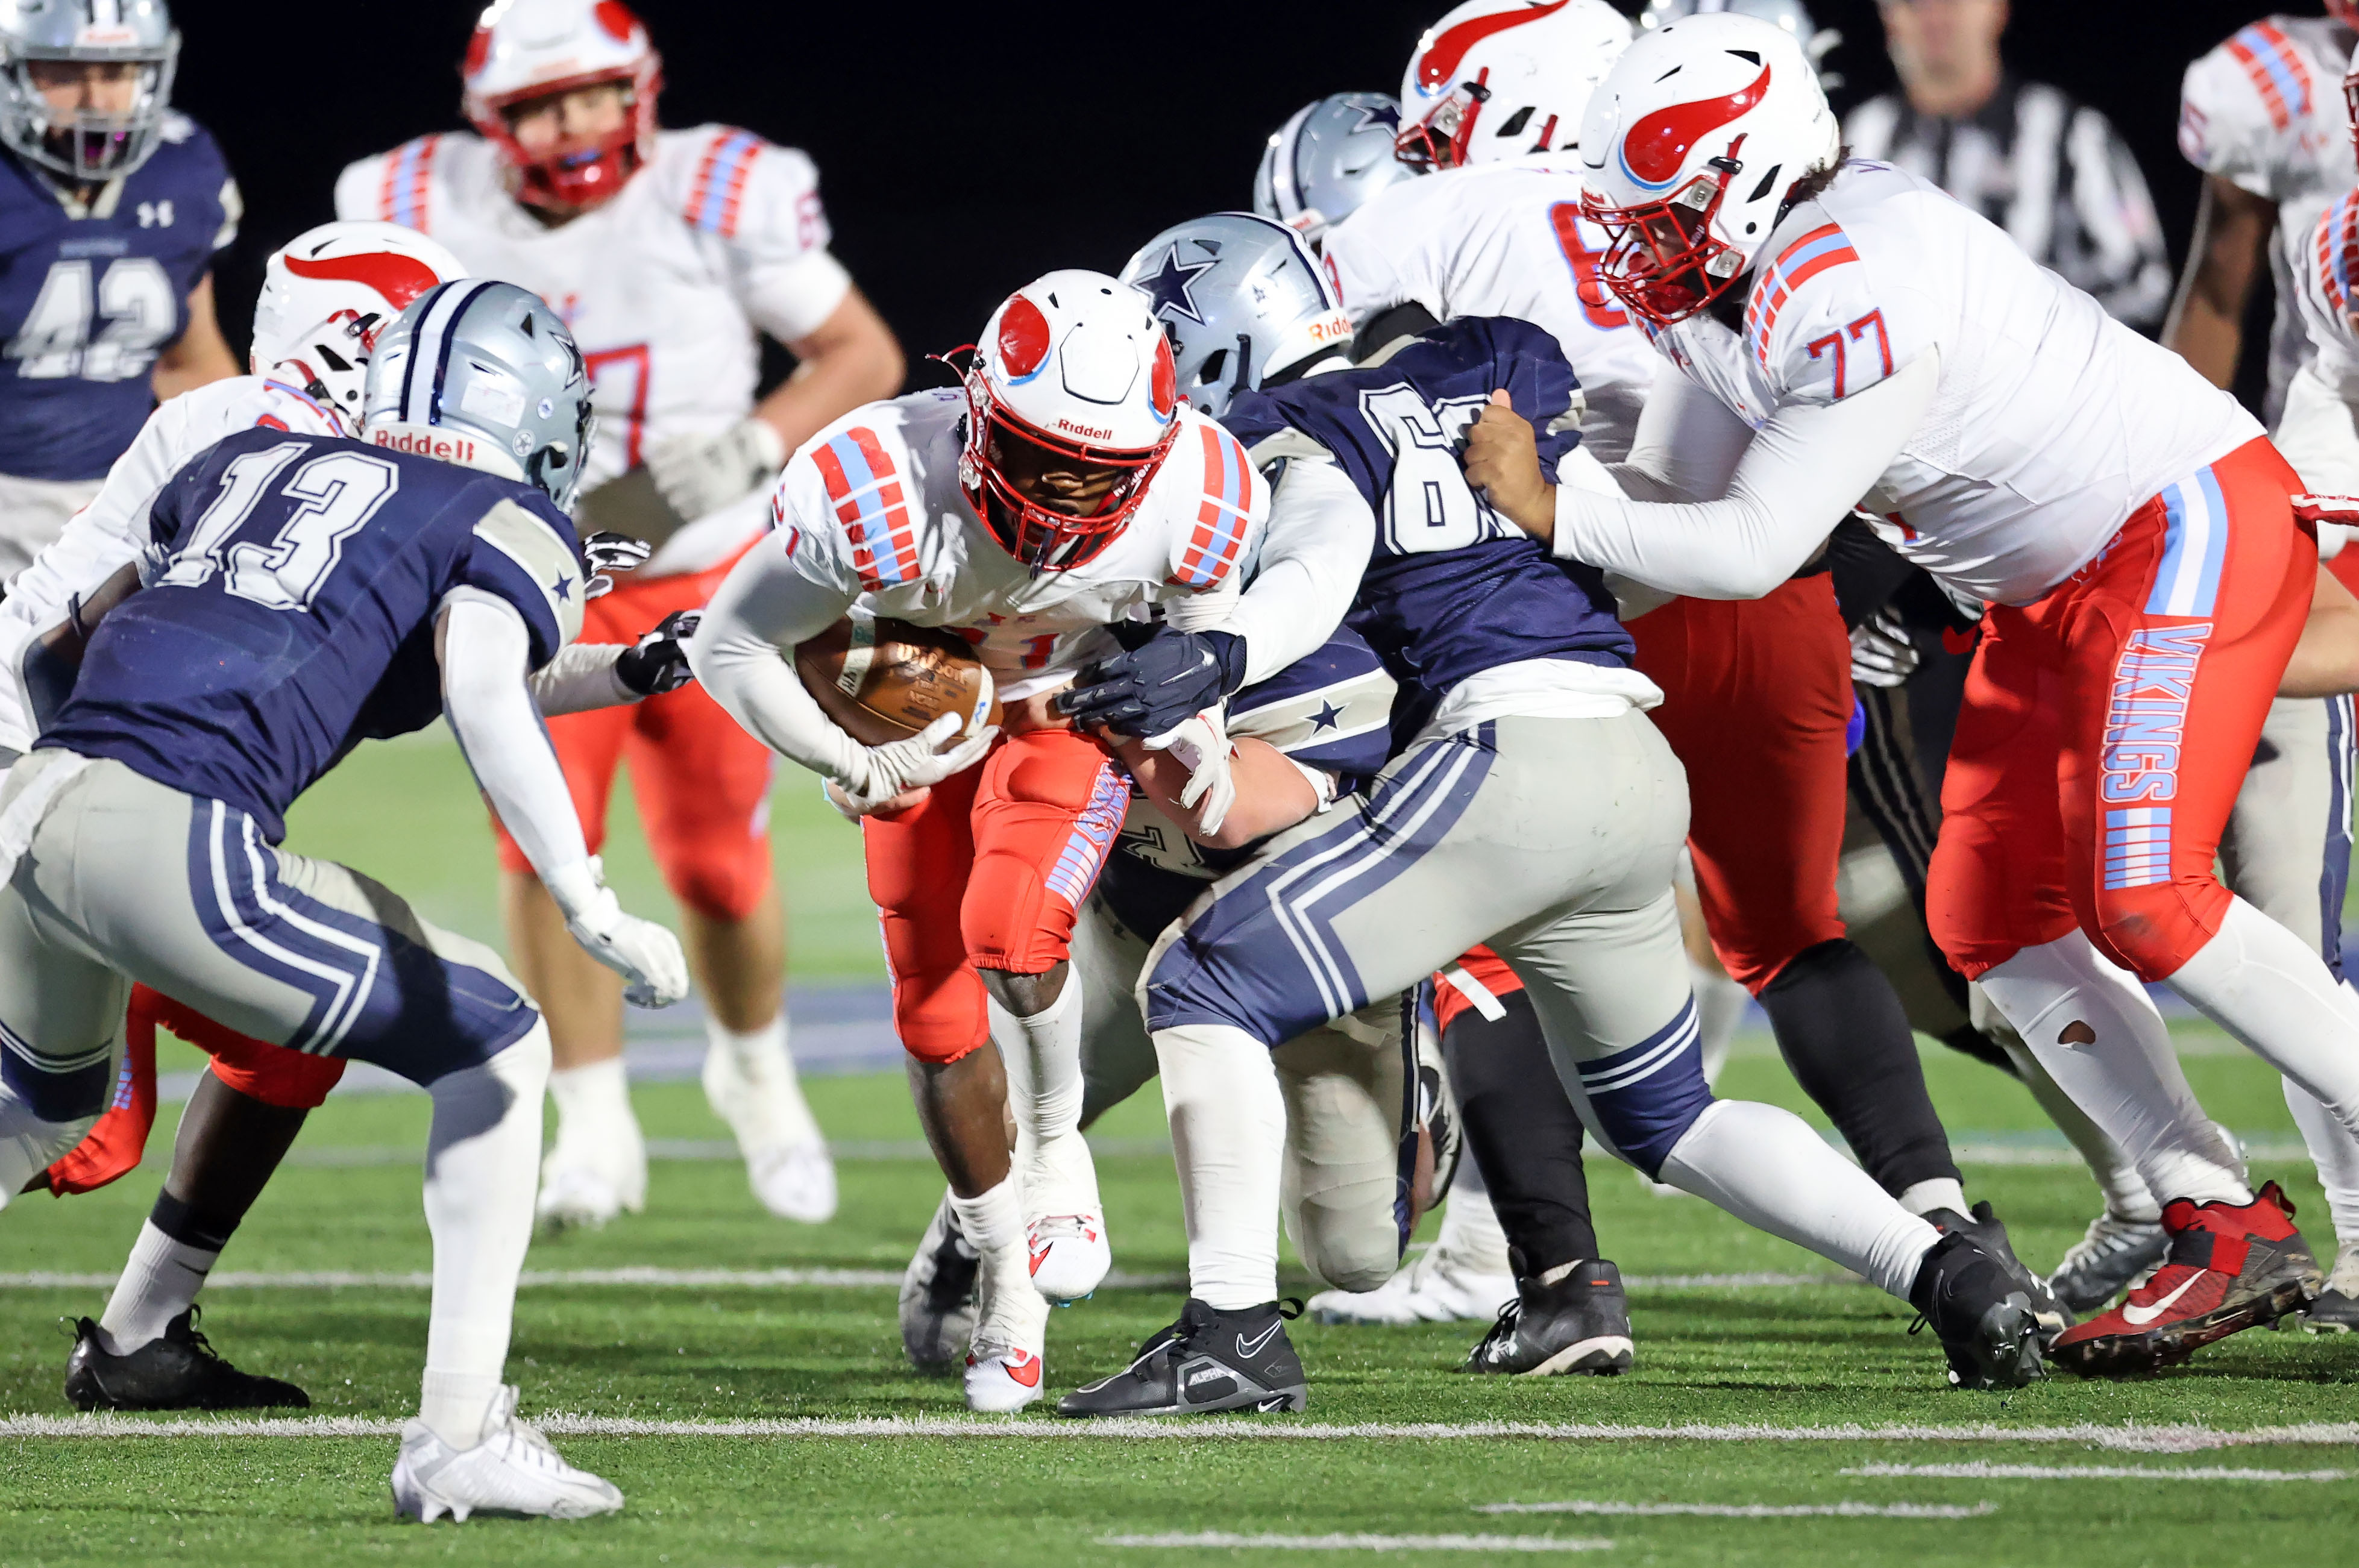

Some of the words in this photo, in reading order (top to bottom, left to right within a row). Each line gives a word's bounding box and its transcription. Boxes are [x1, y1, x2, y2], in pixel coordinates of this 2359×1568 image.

[3, 256, 177, 383] 42
[1308, 316, 1354, 343] Ridd
[1805, 307, 1894, 400] 77
[375, 430, 474, 462] Riddell
[1058, 418, 1113, 440] Riddell
[154, 442, 399, 612] 13
[2100, 622, 2214, 804] VIKINGS
